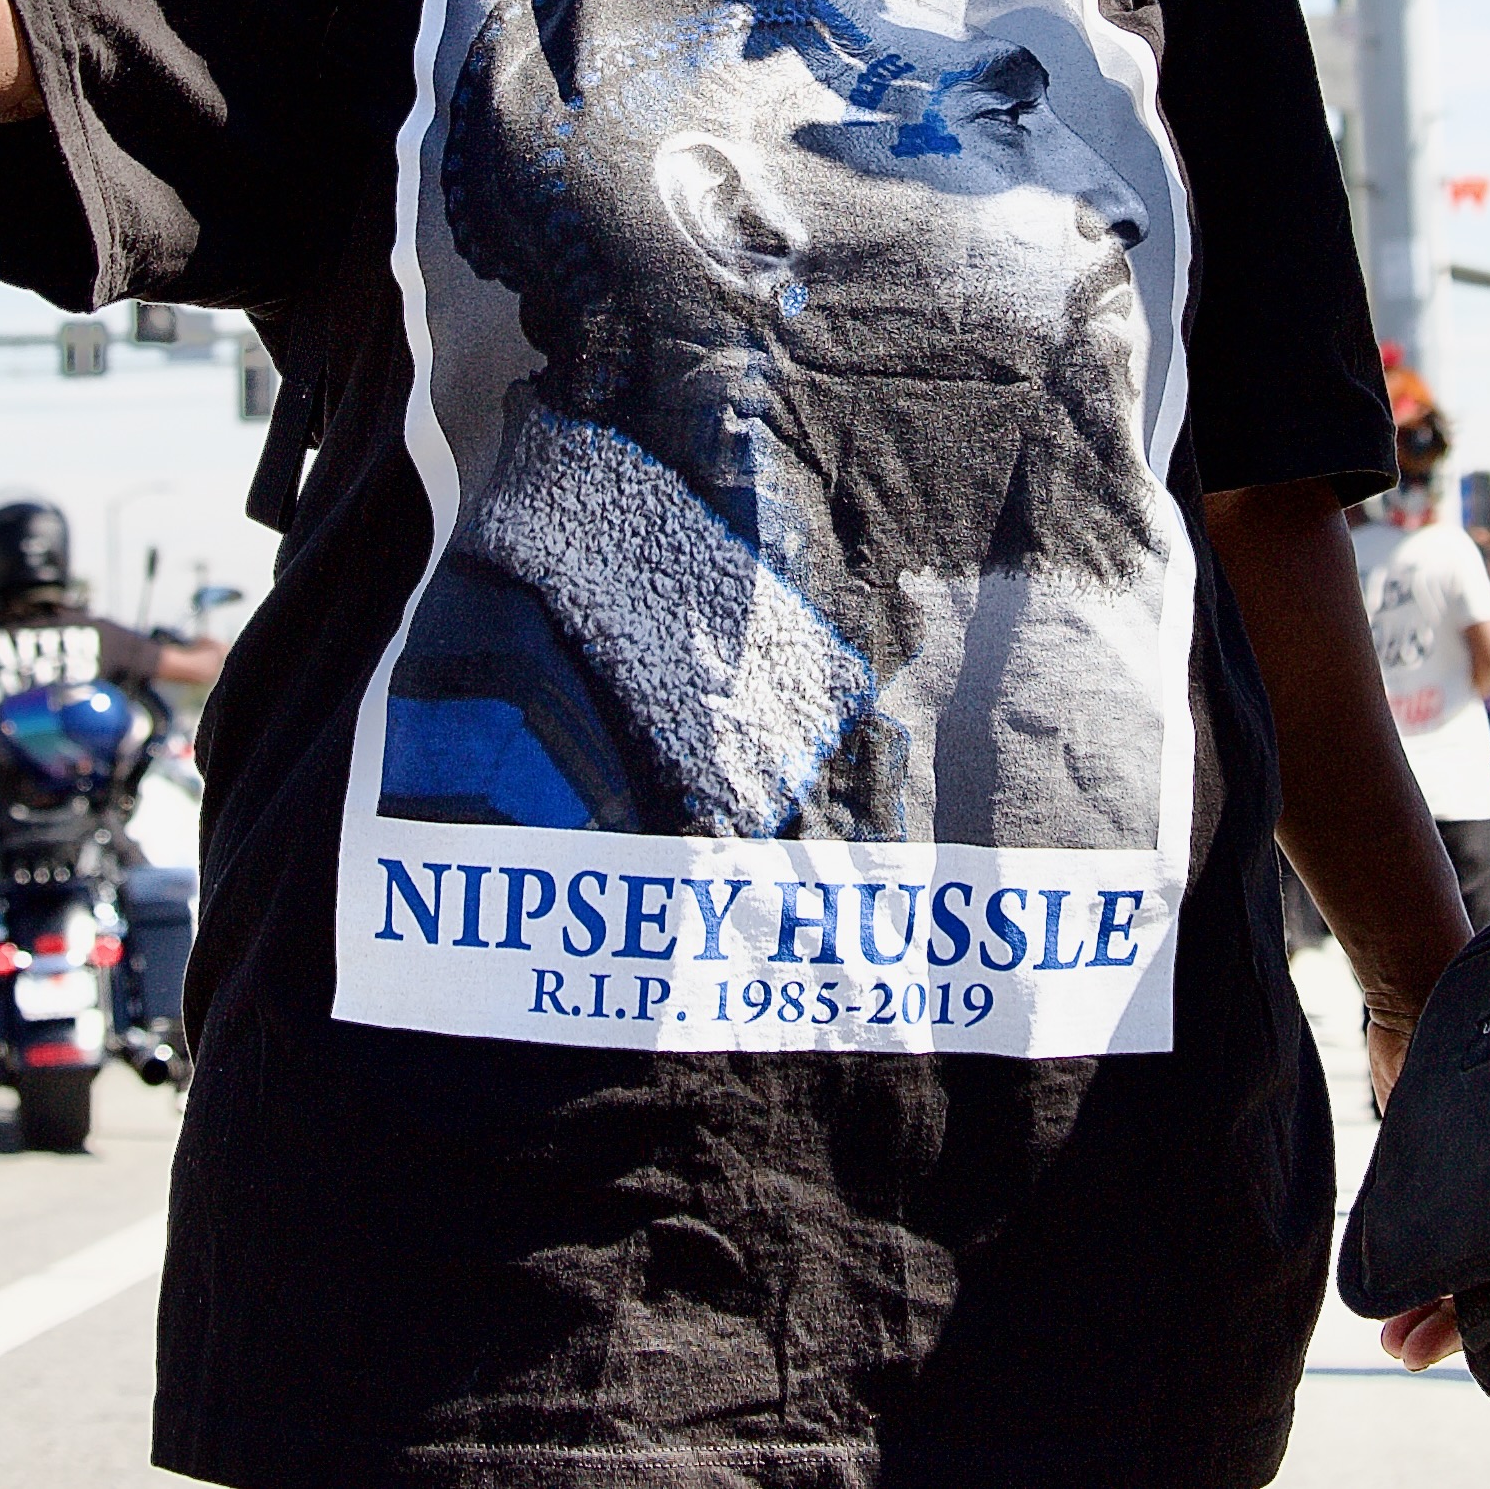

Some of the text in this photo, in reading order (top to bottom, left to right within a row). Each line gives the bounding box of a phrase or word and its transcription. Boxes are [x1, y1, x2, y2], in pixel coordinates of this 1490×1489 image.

[374, 857, 1145, 972] NIPSEY HUSSLE
[529, 967, 995, 1029] R.I.P. 1985-2019
